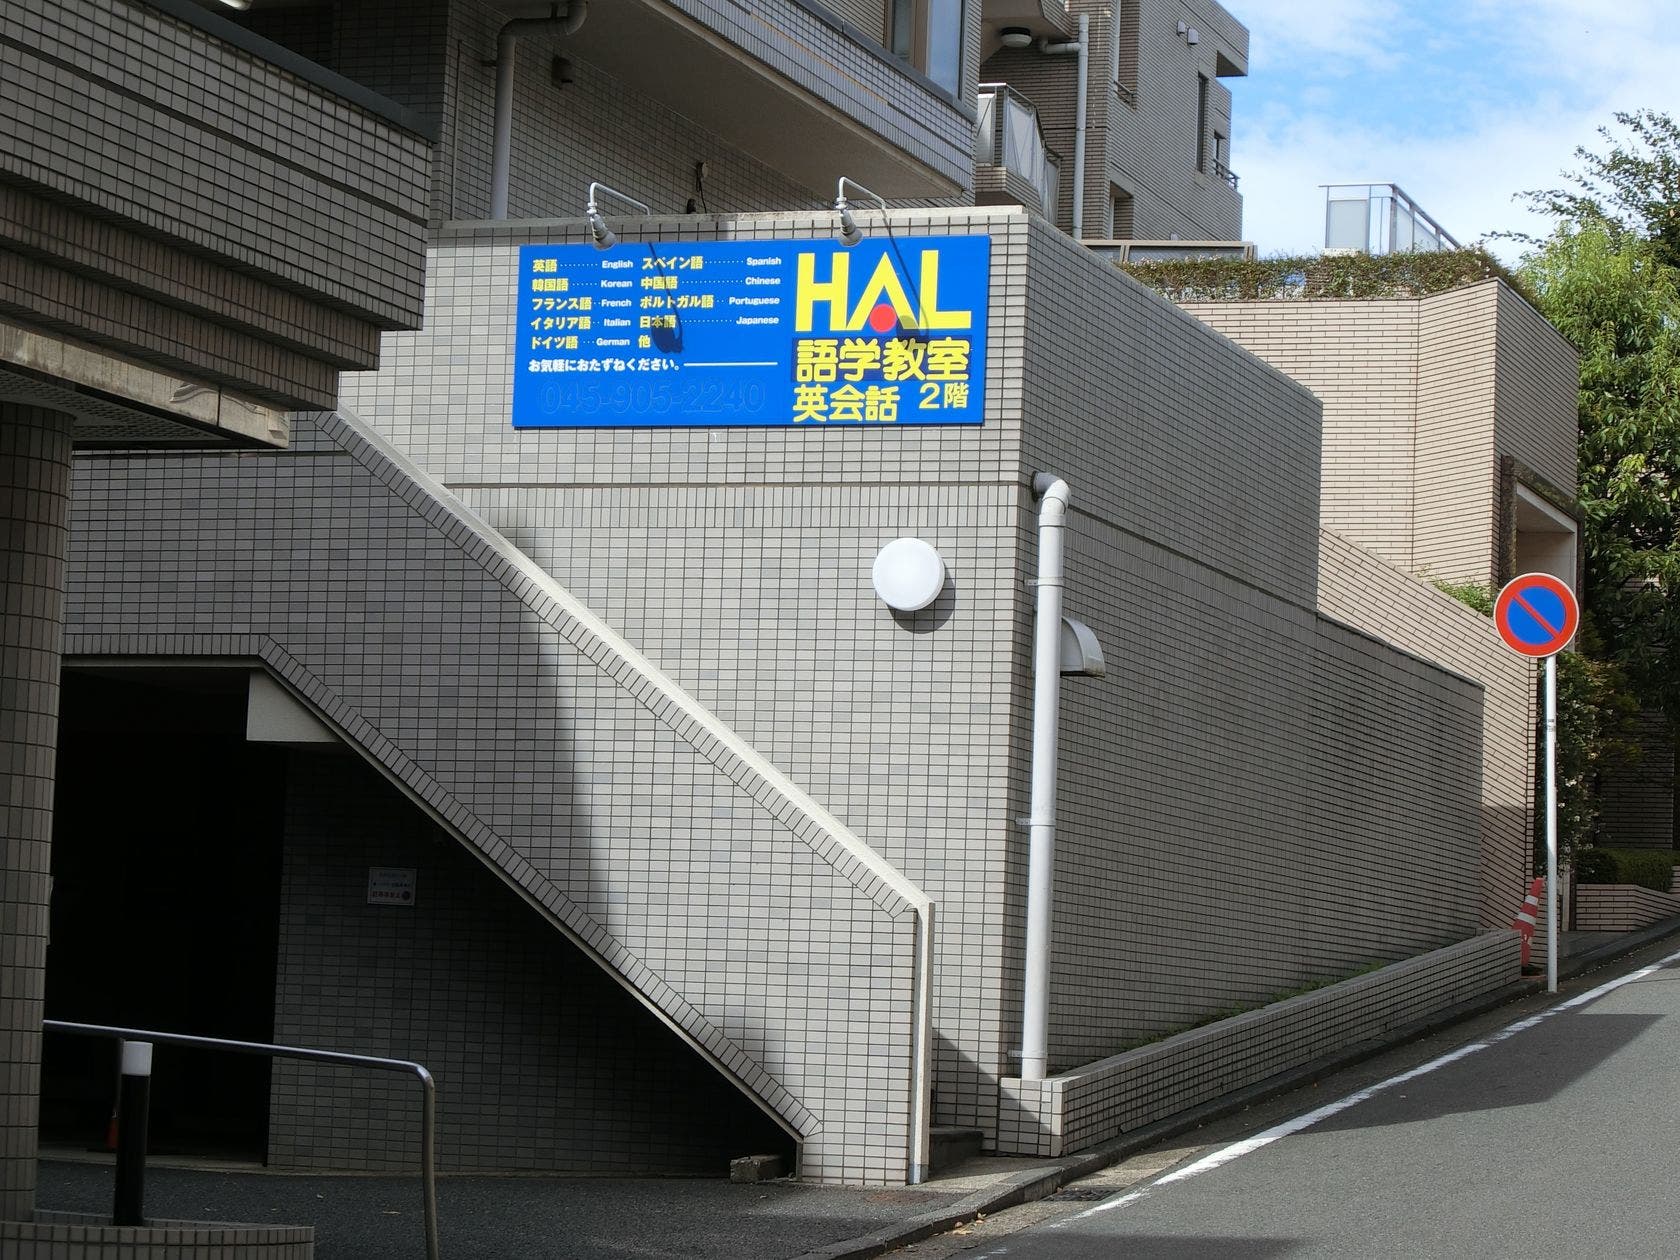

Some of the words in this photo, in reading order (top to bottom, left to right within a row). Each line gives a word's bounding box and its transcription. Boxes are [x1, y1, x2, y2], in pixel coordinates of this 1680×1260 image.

[533, 259, 558, 273] 英語
[601, 260, 634, 269] English
[642, 256, 704, 270] スペイン語
[746, 257, 782, 266] Spanish
[532, 278, 569, 292] 韓国語
[600, 280, 633, 288] Korean
[640, 276, 678, 290] 中国語
[745, 277, 781, 285] Chinese
[795, 249, 972, 332] HAL
[532, 297, 592, 311] フランス語
[601, 299, 632, 307] French
[640, 294, 714, 309] ポルトガル語
[729, 297, 780, 305] Portuguese
[531, 316, 591, 330] イタリア語
[603, 318, 631, 327] Italian
[640, 315, 677, 328] 日本語
[736, 316, 780, 325] Japanese
[532, 335, 579, 350] ドイツ語
[596, 337, 631, 346] German
[638, 335, 651, 348] 他
[528, 358, 680, 373] お気軽におたずねください。
[796, 336, 971, 382] 語学教室
[793, 384, 900, 422] 英会話
[919, 382, 970, 409] 2階
